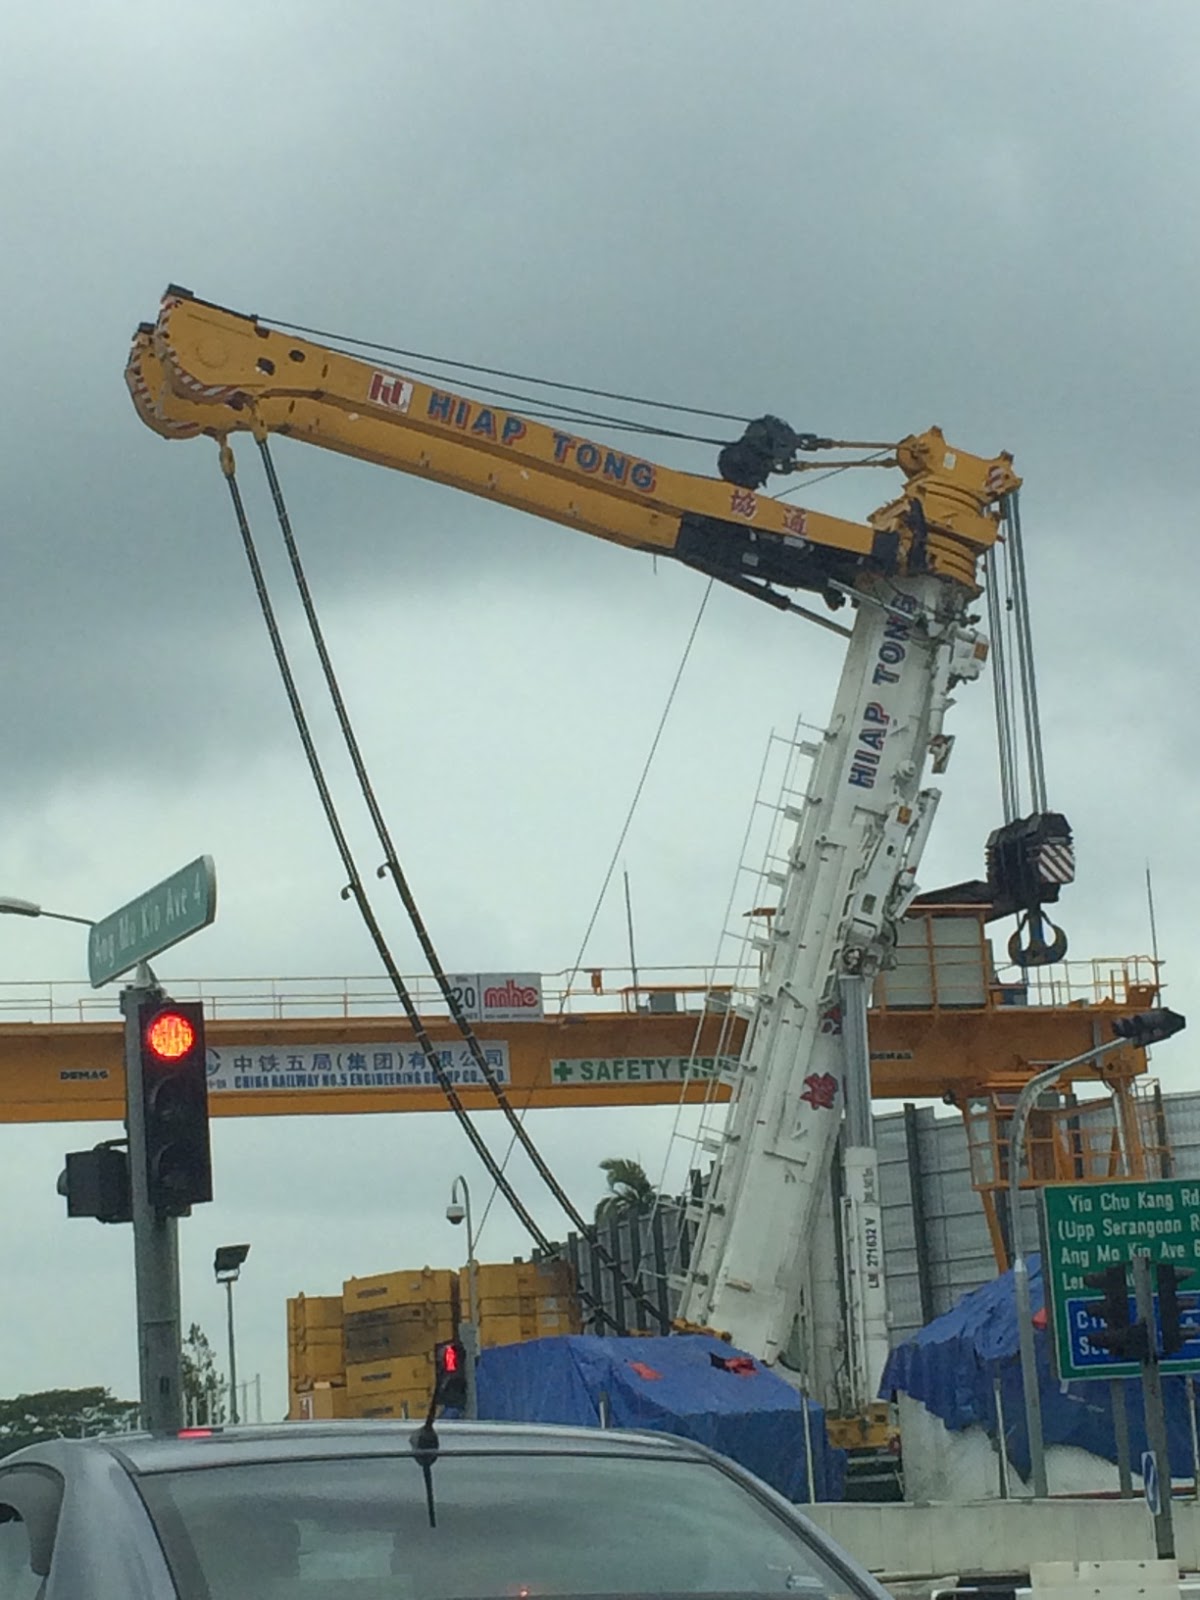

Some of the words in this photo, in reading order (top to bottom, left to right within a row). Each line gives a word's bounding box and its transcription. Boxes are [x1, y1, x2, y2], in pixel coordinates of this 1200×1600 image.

[427, 391, 527, 446] HIAP
[553, 431, 656, 493] TONG
[848, 701, 890, 789] HIAP
[93, 932, 115, 969] Ang
[119, 911, 137, 951] Mo
[166, 887, 187, 926] Ave
[193, 871, 201, 906] 4
[60, 1070, 109, 1080] DEMAG
[234, 1074, 269, 1089] CHINA
[271, 1073, 320, 1089] RAILWAY
[350, 1070, 422, 1086] ENGINEERING
[580, 1059, 671, 1080] SAFETY
[1068, 1195, 1092, 1213] Yio
[1100, 1193, 1130, 1211] Chu
[1138, 1192, 1174, 1212] Kang
[1181, 1188, 1200, 1207] Rd
[1058, 1219, 1095, 1242] (Upp
[1103, 1218, 1182, 1239] Serangoon
[1061, 1247, 1090, 1268] Ang
[1097, 1244, 1120, 1262] Mo
[1160, 1241, 1185, 1259] Ave
